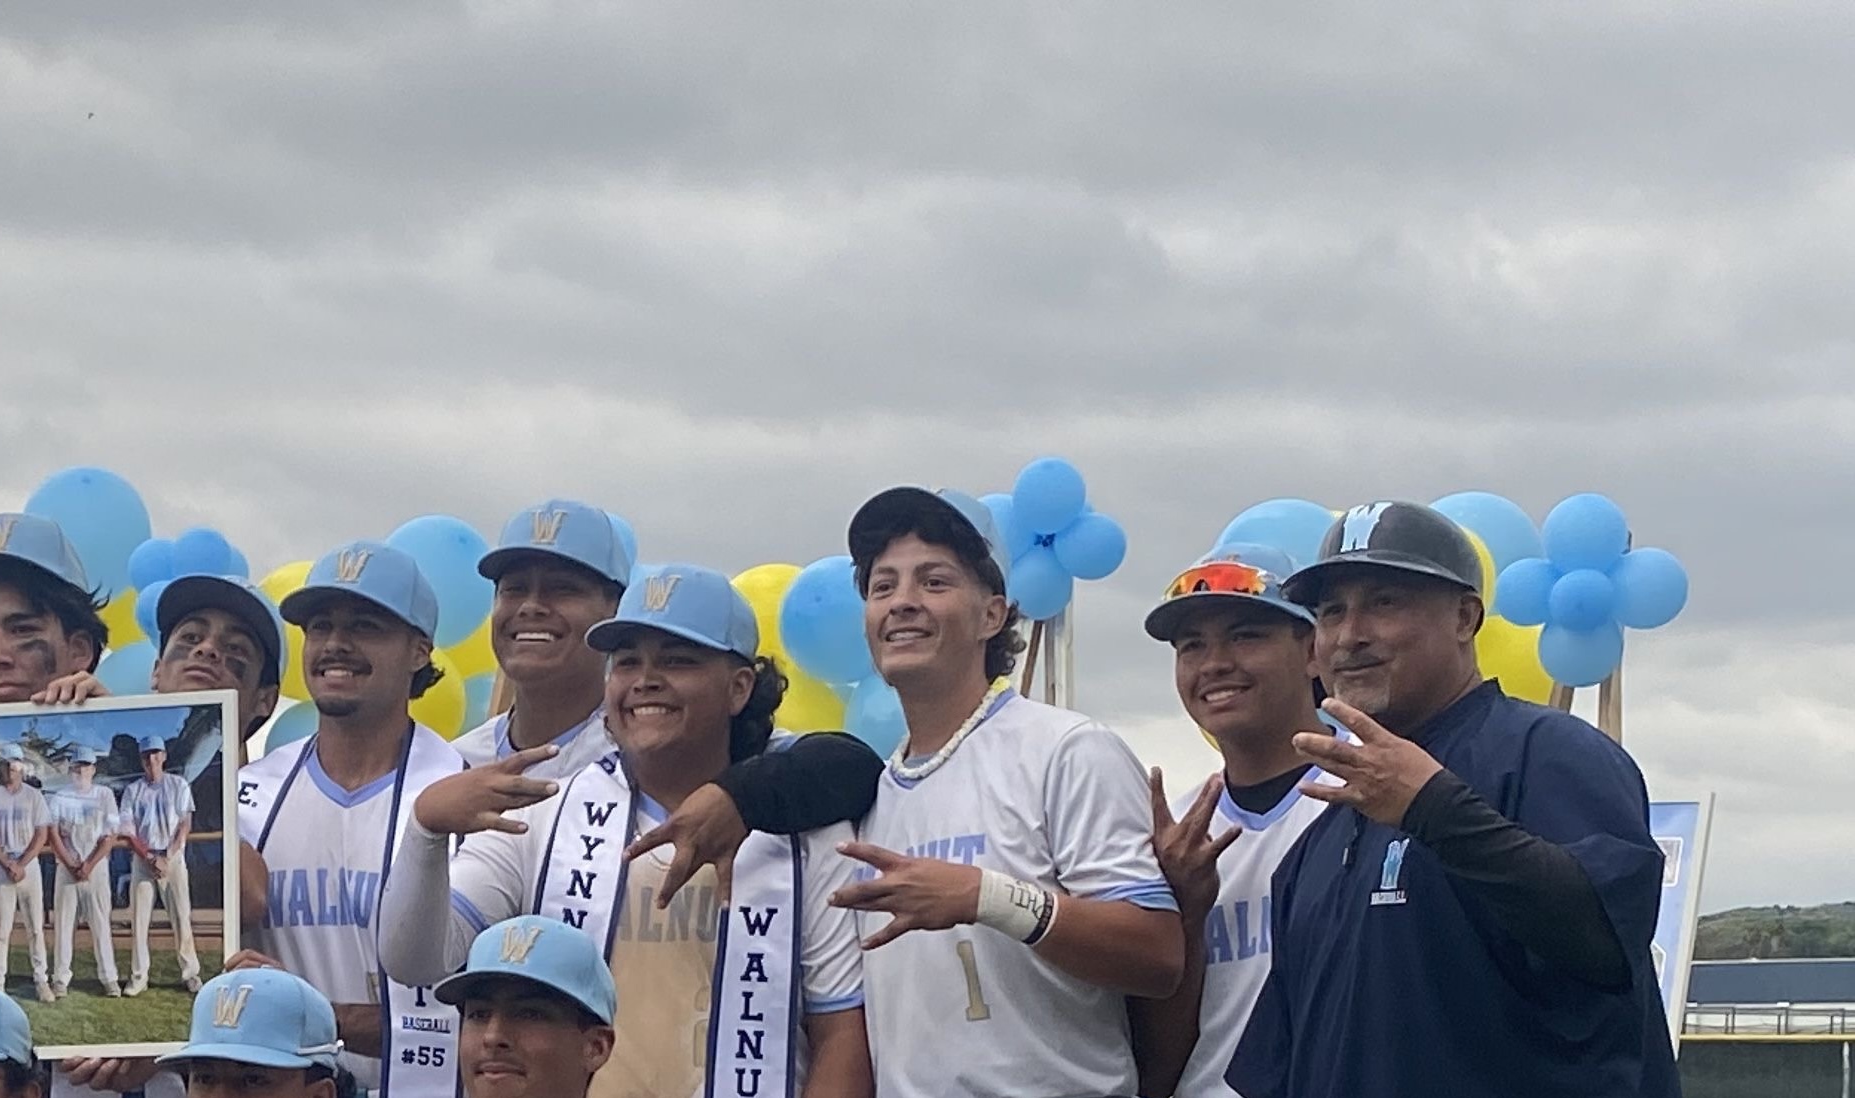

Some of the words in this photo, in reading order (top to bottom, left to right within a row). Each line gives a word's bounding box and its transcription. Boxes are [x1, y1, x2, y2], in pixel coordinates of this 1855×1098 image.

[531, 510, 567, 544] W
[1340, 502, 1390, 551] W
[336, 549, 372, 582] W
[643, 576, 682, 611] W
[500, 925, 544, 964] W
[955, 939, 992, 1022] 1
[211, 985, 252, 1029] W
[402, 1046, 446, 1068] #55
